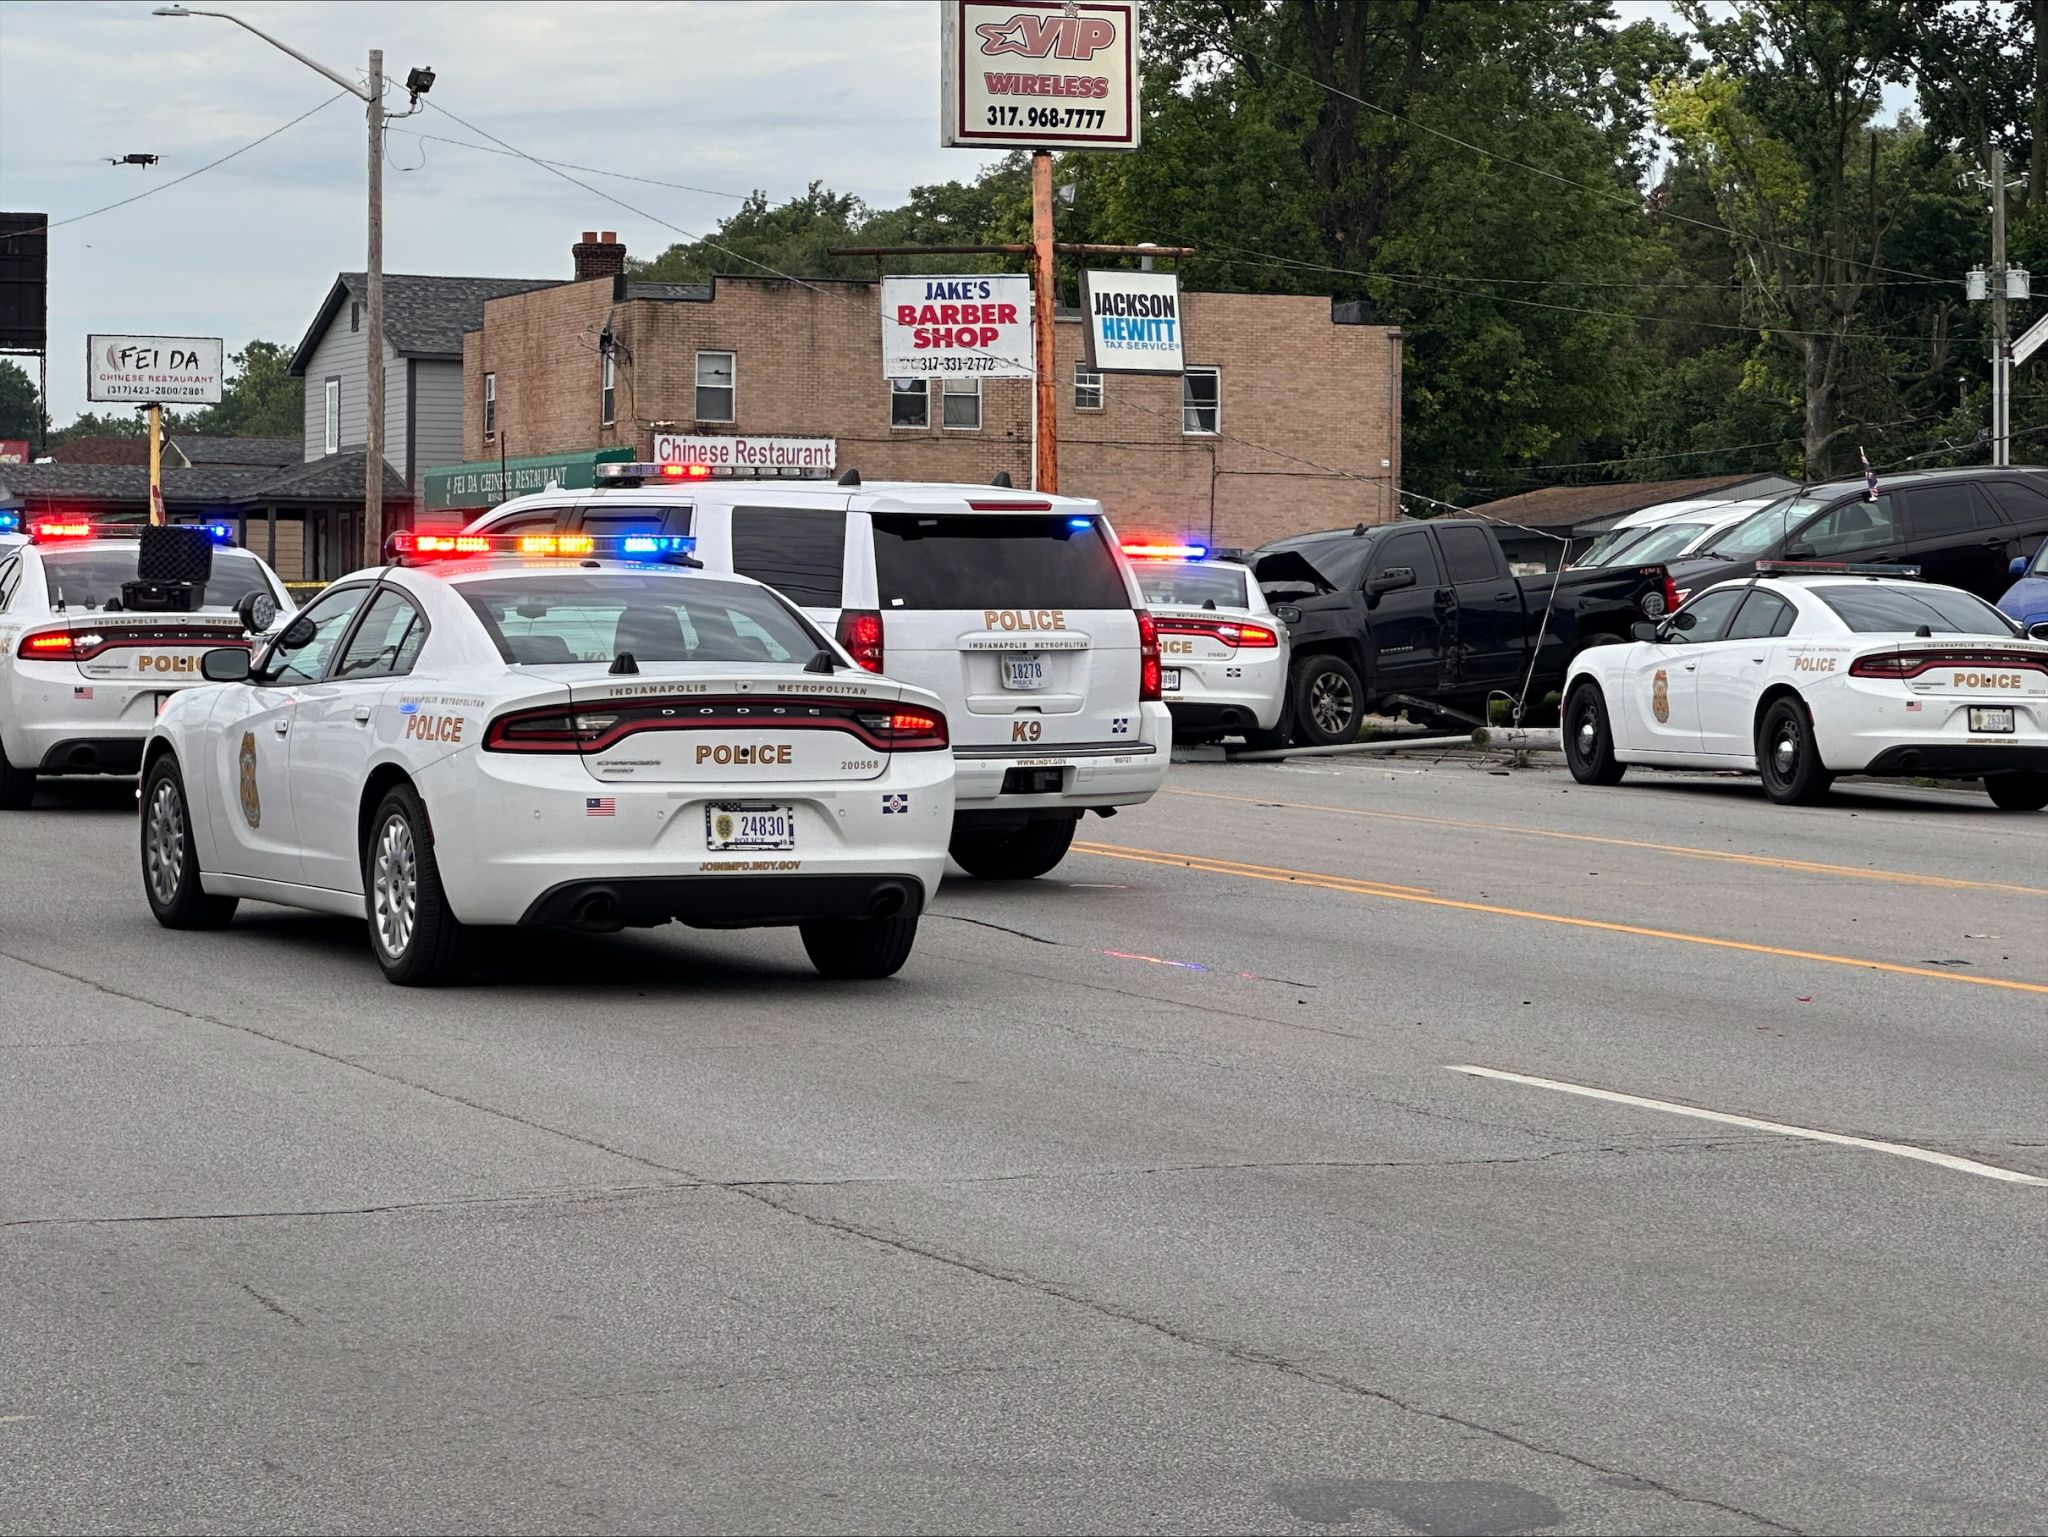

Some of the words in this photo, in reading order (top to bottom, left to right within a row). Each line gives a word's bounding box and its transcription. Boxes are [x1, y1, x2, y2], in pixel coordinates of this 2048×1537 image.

[976, 14, 1116, 60] VIP
[984, 72, 1109, 98] WIRELESS
[1028, 108, 1106, 129] 968-7777
[925, 281, 991, 300] JAKE'S
[897, 304, 1018, 326] BARBER
[1094, 292, 1175, 318] JACKSON
[913, 327, 999, 349] SHOP
[1102, 317, 1176, 342] HEWITT
[1104, 340, 1124, 350] TAX
[118, 346, 159, 370] FEI
[170, 350, 200, 370] DA
[920, 356, 994, 371] 317-331-2772
[100, 373, 144, 382] CHINESE
[148, 375, 214, 384] RESTAURANT
[659, 437, 729, 463] Chinese
[735, 439, 831, 465] Restaurant
[453, 475, 465, 494] FEI
[467, 474, 478, 493] DA
[480, 471, 512, 492] CHINESE
[515, 467, 567, 489] RESTAURANT
[984, 610, 1066, 630] POLICE
[1162, 641, 1192, 653] ICE
[138, 656, 202, 672] POLI
[1012, 663, 1042, 678] 18278
[1793, 657, 1836, 671] POLICE
[1163, 674, 1177, 684] 890
[1954, 673, 2021, 688] POLICE
[609, 685, 707, 696] INDIANAPOLIS
[777, 684, 868, 695] METROPOLITAN
[441, 697, 485, 707] METROPOLITAN
[406, 715, 464, 742] POLICE
[1012, 721, 1042, 742] K9
[696, 744, 792, 765] POLICE
[841, 760, 879, 770] 200568
[741, 816, 784, 836] 24830
